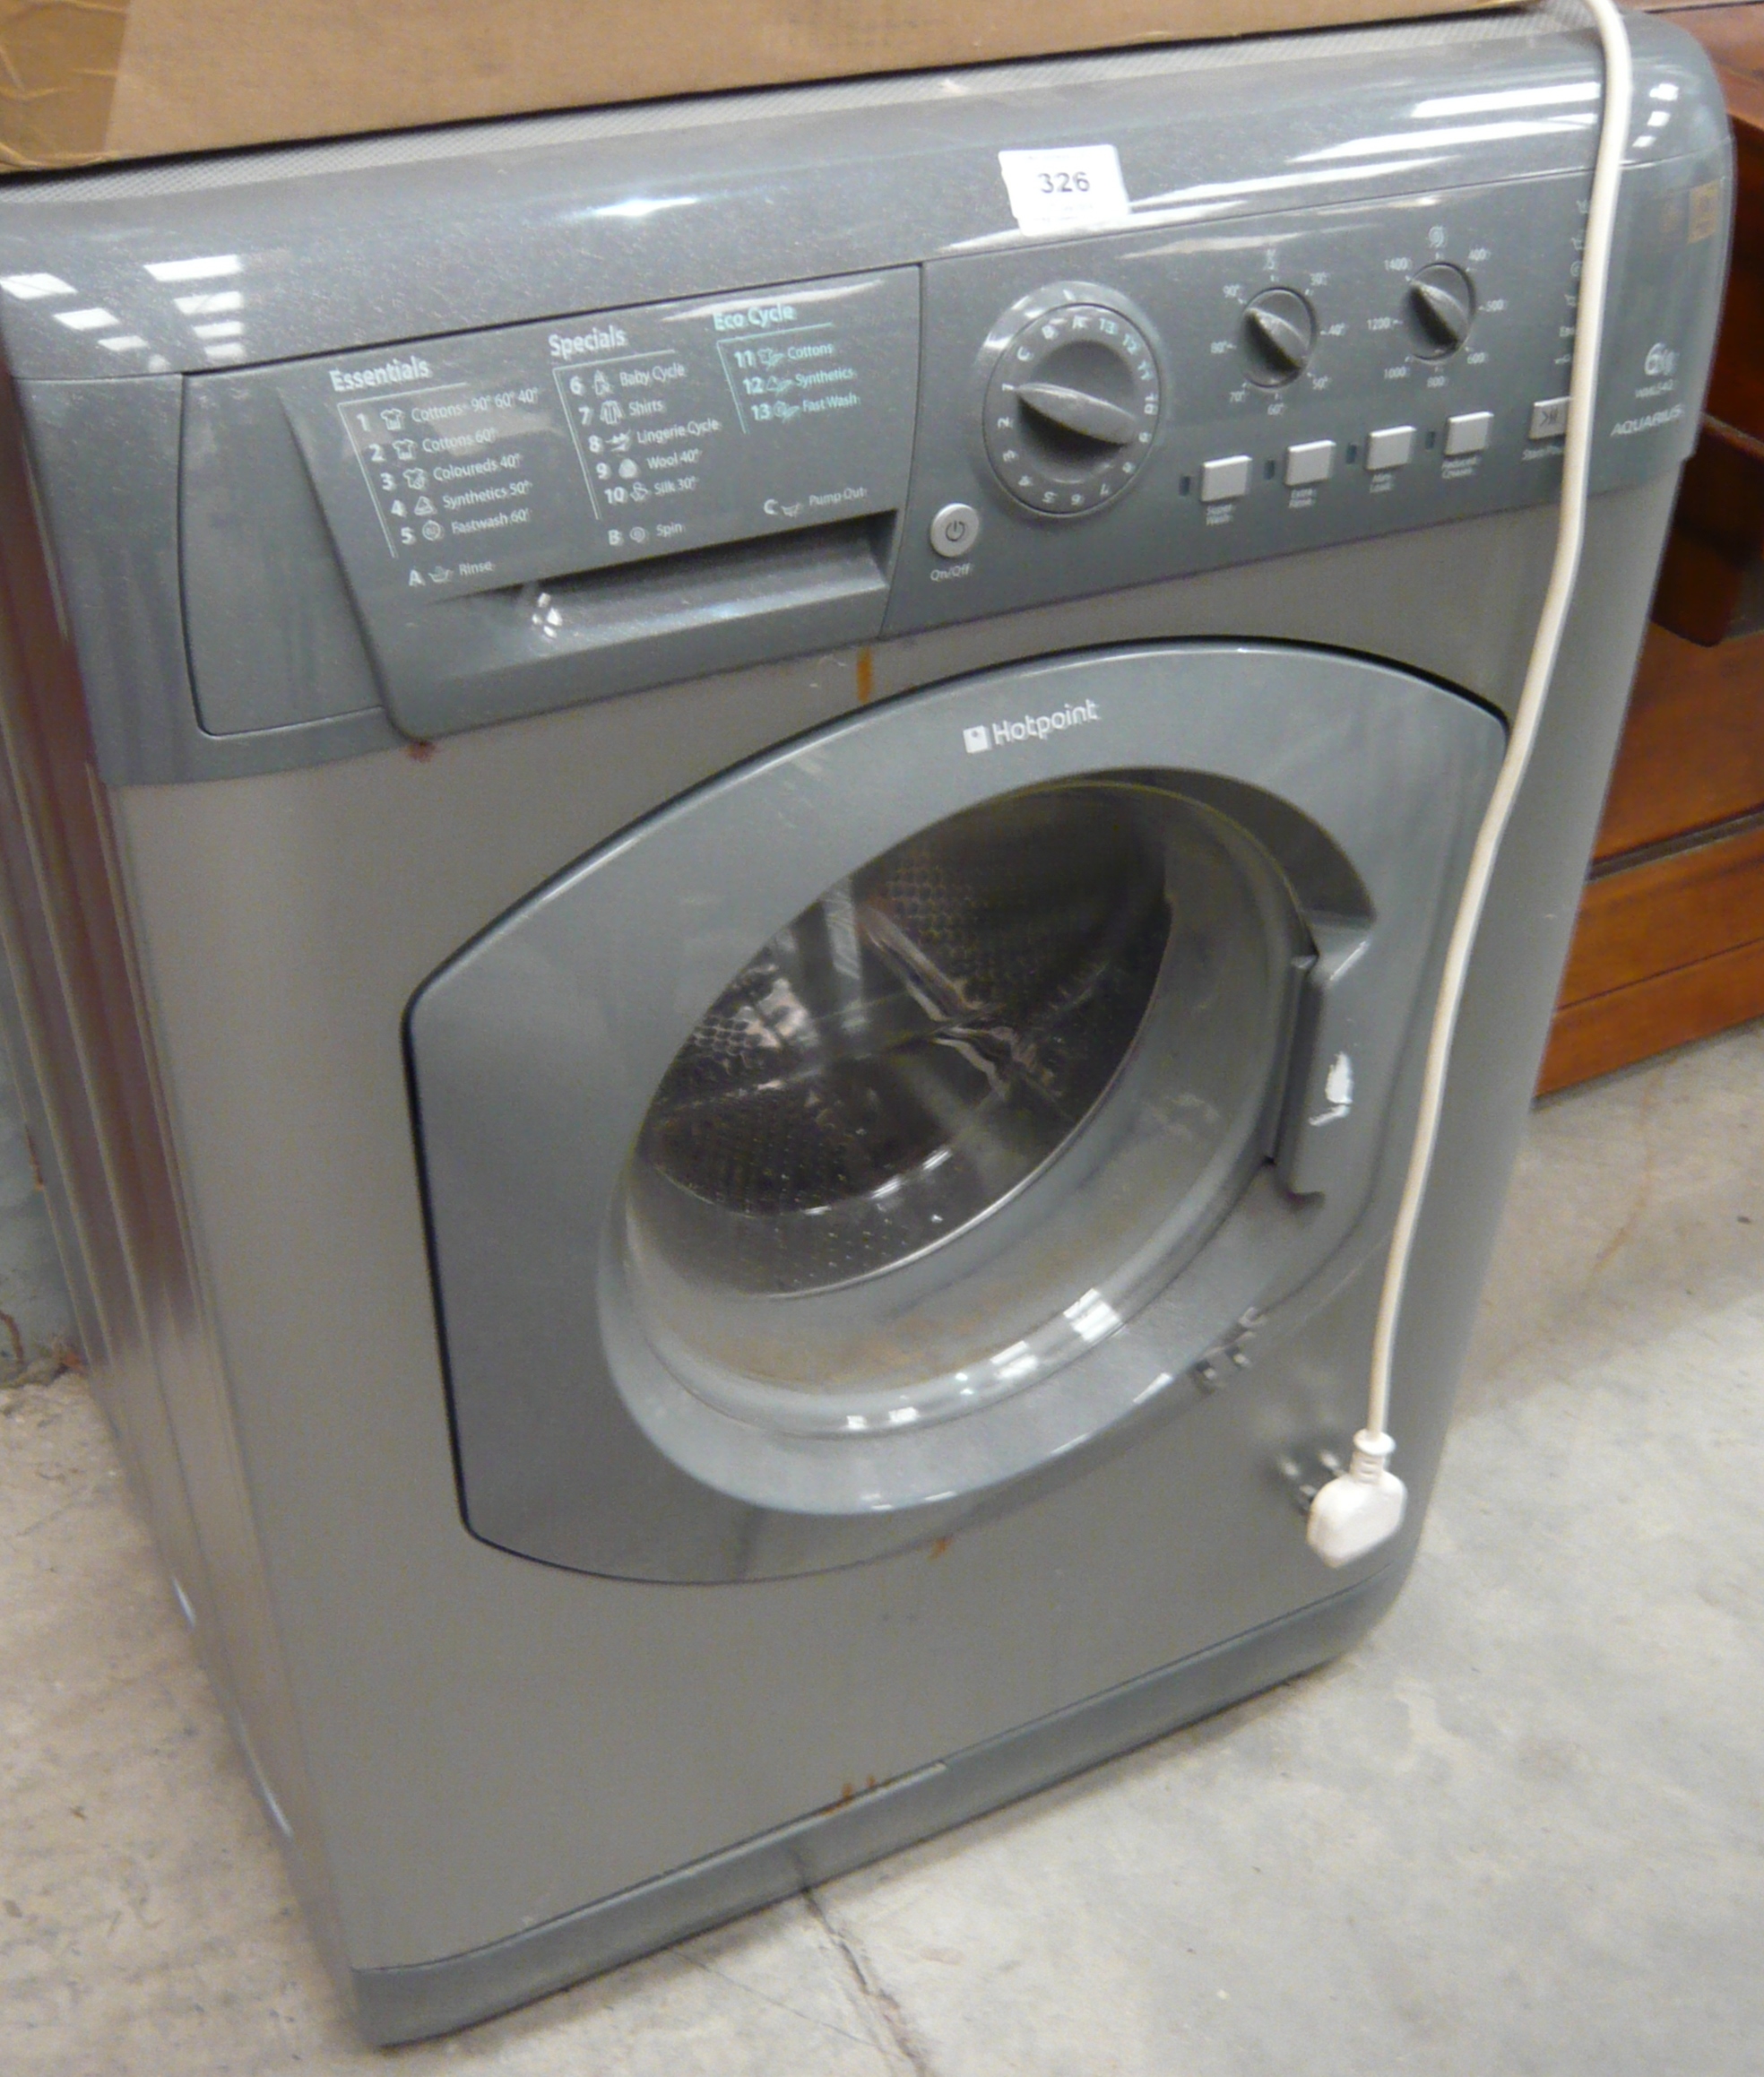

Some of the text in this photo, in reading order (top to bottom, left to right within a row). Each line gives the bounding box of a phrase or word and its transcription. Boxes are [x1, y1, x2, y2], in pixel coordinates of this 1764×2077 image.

[1037, 171, 1090, 194] 326
[713, 301, 797, 331] Eco Cycle
[549, 325, 627, 360] Specials
[734, 342, 834, 368] 11 Cottons
[329, 355, 431, 392] Essentials
[569, 362, 687, 396] 6 Baby Cycle
[742, 368, 856, 395] 12 Synthetics
[357, 413, 370, 431] 1
[578, 400, 665, 426] 7 Shirts
[750, 403, 773, 420] 13
[1610, 403, 1685, 437] AQUARIUS
[368, 443, 386, 462] 2
[422, 435, 473, 454] Cottons
[588, 418, 722, 454] 8 Lingerie Cycle
[380, 472, 396, 490] 3
[434, 458, 499, 481] Coloureds
[596, 463, 610, 480] 9
[646, 452, 679, 470] Wool
[391, 499, 407, 517] 4
[443, 487, 509, 510] Synthetics
[604, 487, 627, 505] 10
[653, 480, 676, 497] Silk
[764, 487, 867, 515] C Pump Out
[401, 527, 417, 545] 5
[451, 512, 508, 534] Fastwash
[608, 522, 684, 546] B Spin
[409, 561, 494, 586] A Rinse
[930, 562, 973, 582] On/Off
[991, 698, 1101, 745] Hotpoint
